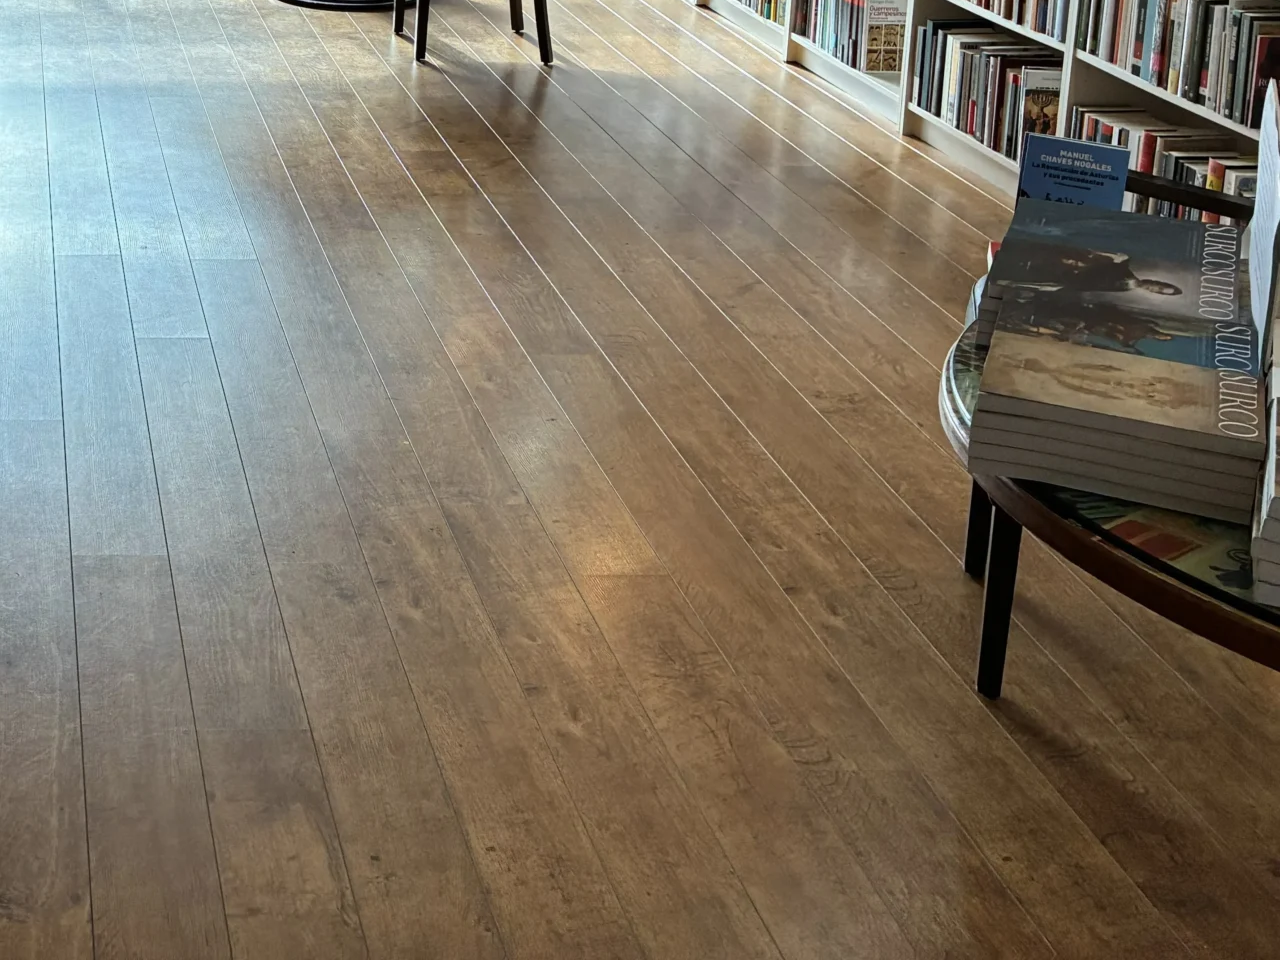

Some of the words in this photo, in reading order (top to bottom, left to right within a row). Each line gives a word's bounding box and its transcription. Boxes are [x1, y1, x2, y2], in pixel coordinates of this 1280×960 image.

[1040, 154, 1073, 166] CHAVES
[1073, 160, 1112, 172] NOGALES
[1041, 163, 1079, 175] Revolución
[1089, 171, 1120, 181] Asturias
[1059, 149, 1095, 162] MANUEL
[1198, 267, 1236, 320] SURCO
[1214, 324, 1252, 372] SURC
[1217, 371, 1260, 438] SURCO
